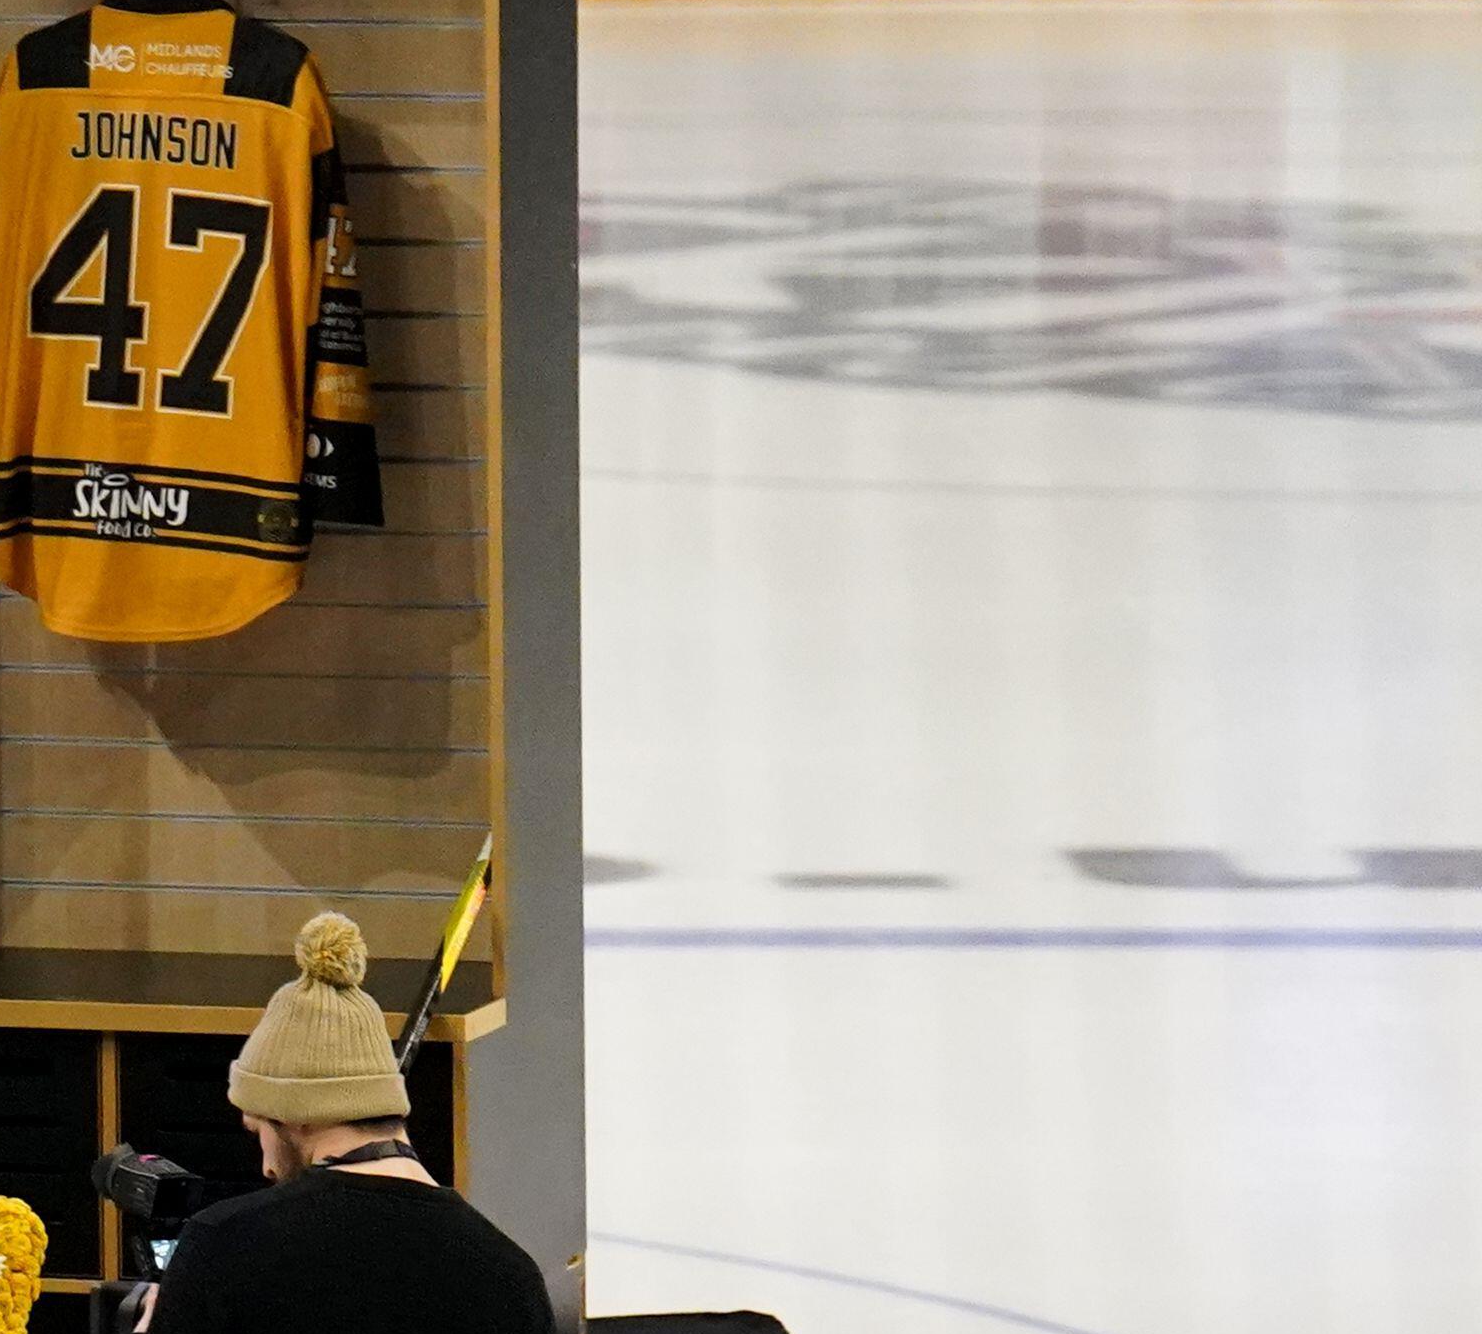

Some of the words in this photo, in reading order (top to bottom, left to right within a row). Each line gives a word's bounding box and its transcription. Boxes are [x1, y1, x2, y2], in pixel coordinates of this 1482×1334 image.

[145, 42, 223, 60] MIDLANDS
[70, 111, 238, 171] JOHNSON
[26, 182, 274, 420] 47
[72, 478, 190, 527] SKINNY
